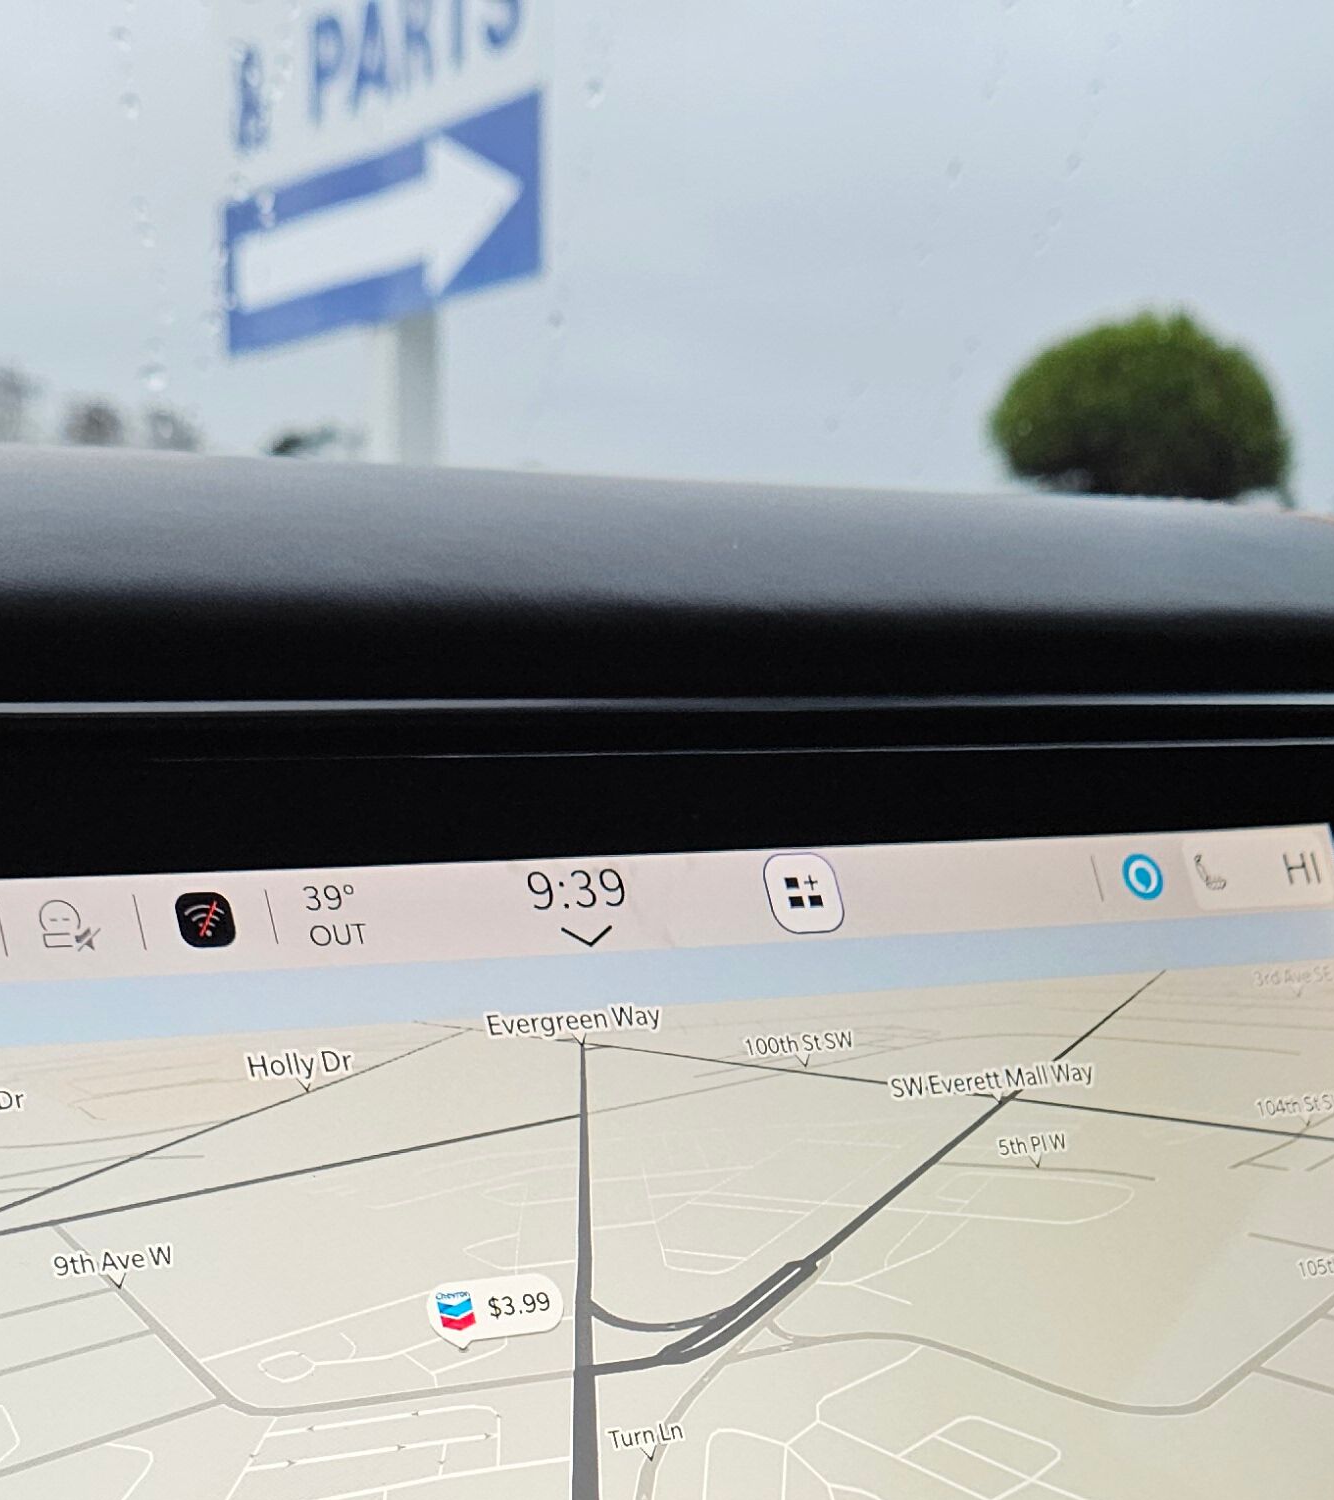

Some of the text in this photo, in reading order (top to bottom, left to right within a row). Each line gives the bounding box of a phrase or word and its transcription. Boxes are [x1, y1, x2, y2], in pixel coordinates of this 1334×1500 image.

[1283, 852, 1322, 886] HI
[527, 868, 627, 910] 9:39
[310, 922, 365, 947] OUT
[486, 1005, 661, 1038] Evergreen Way
[744, 1032, 854, 1056] 100th St SW
[248, 1052, 353, 1081] Holly Dr
[890, 1063, 1093, 1099] SW Everett Mall Way
[1256, 1099, 1301, 1118] 104th
[1303, 1097, 1319, 1112] St
[998, 1137, 1029, 1156] 5th
[1050, 1132, 1066, 1150] W
[53, 1246, 172, 1279] 9th Ave W
[487, 1291, 550, 1319] $3.99
[608, 1424, 684, 1449] Turn Ln
